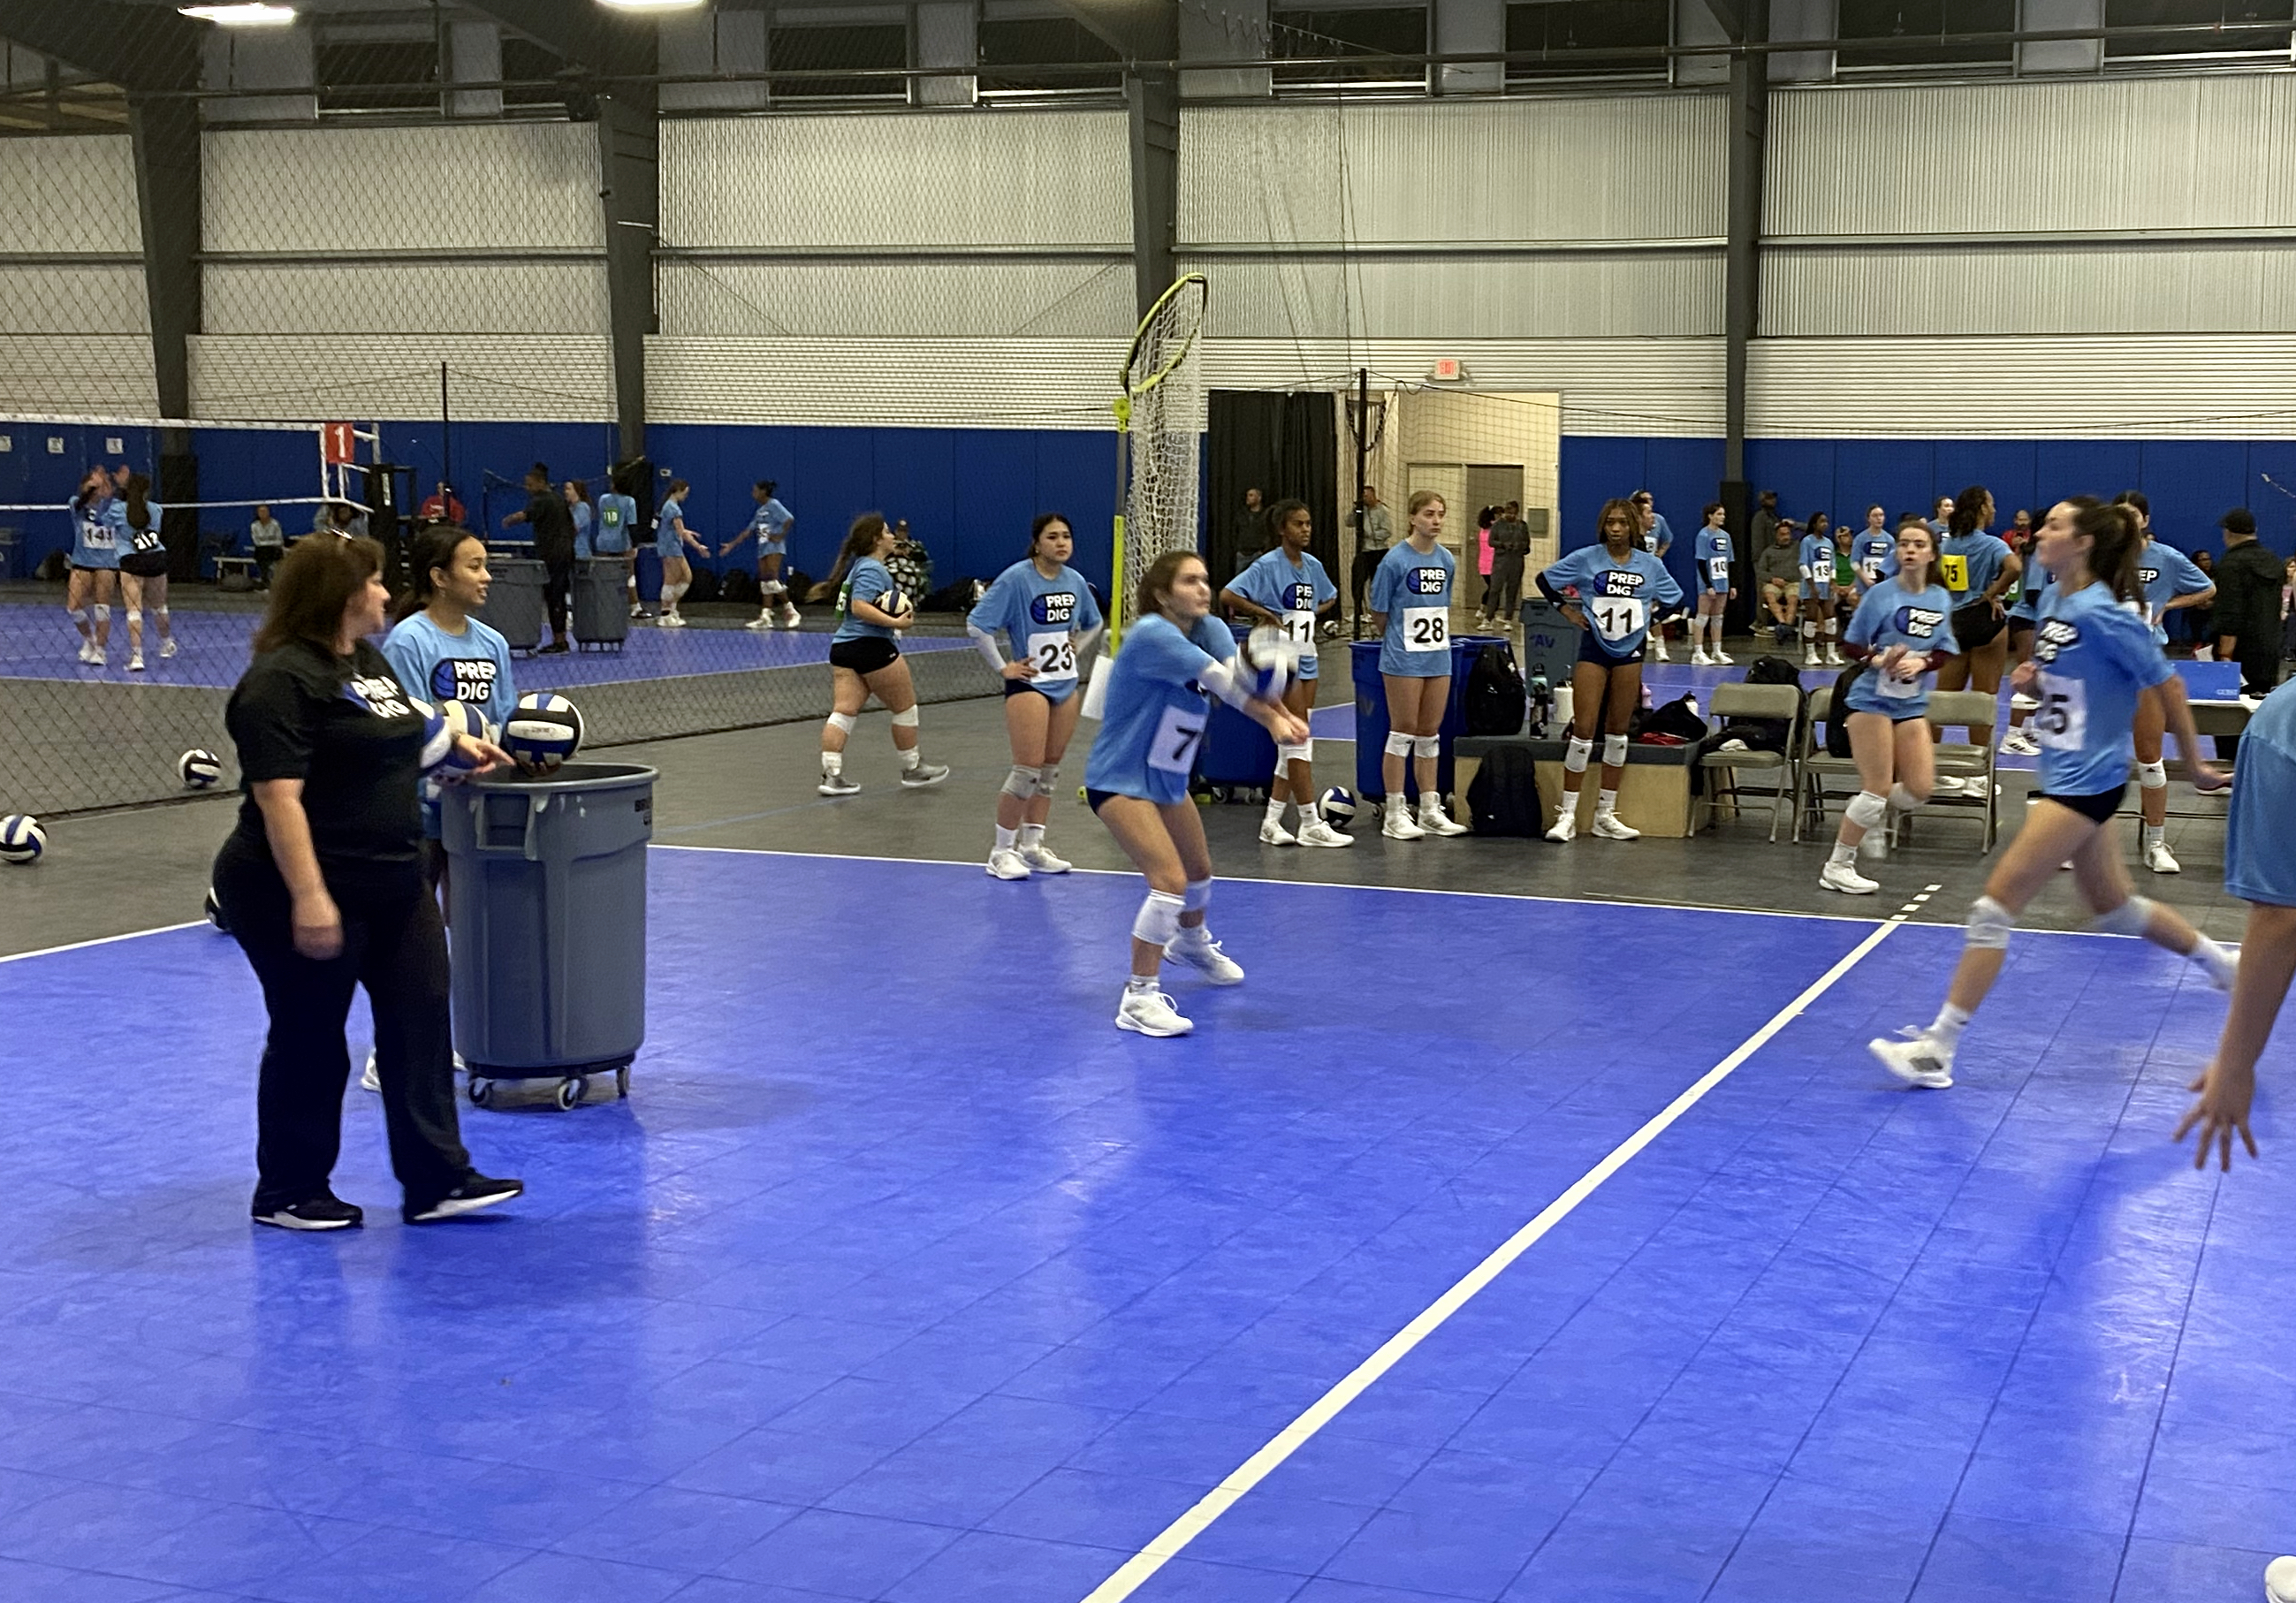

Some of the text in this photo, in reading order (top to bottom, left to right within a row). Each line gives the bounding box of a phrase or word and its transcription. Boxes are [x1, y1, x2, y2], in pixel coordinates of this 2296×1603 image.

[334, 426, 346, 459] 1
[1420, 581, 1441, 592] DIG
[1608, 572, 1643, 586] PREP
[1607, 584, 1631, 596] DIG
[1045, 594, 1076, 607] PREP
[1046, 608, 1069, 622] DIG
[1600, 607, 1632, 634] 11
[1284, 620, 1310, 642] 11
[1413, 618, 1444, 643] 28
[1039, 643, 1072, 672] 23
[454, 661, 497, 680] PREP
[456, 681, 489, 700] DIG
